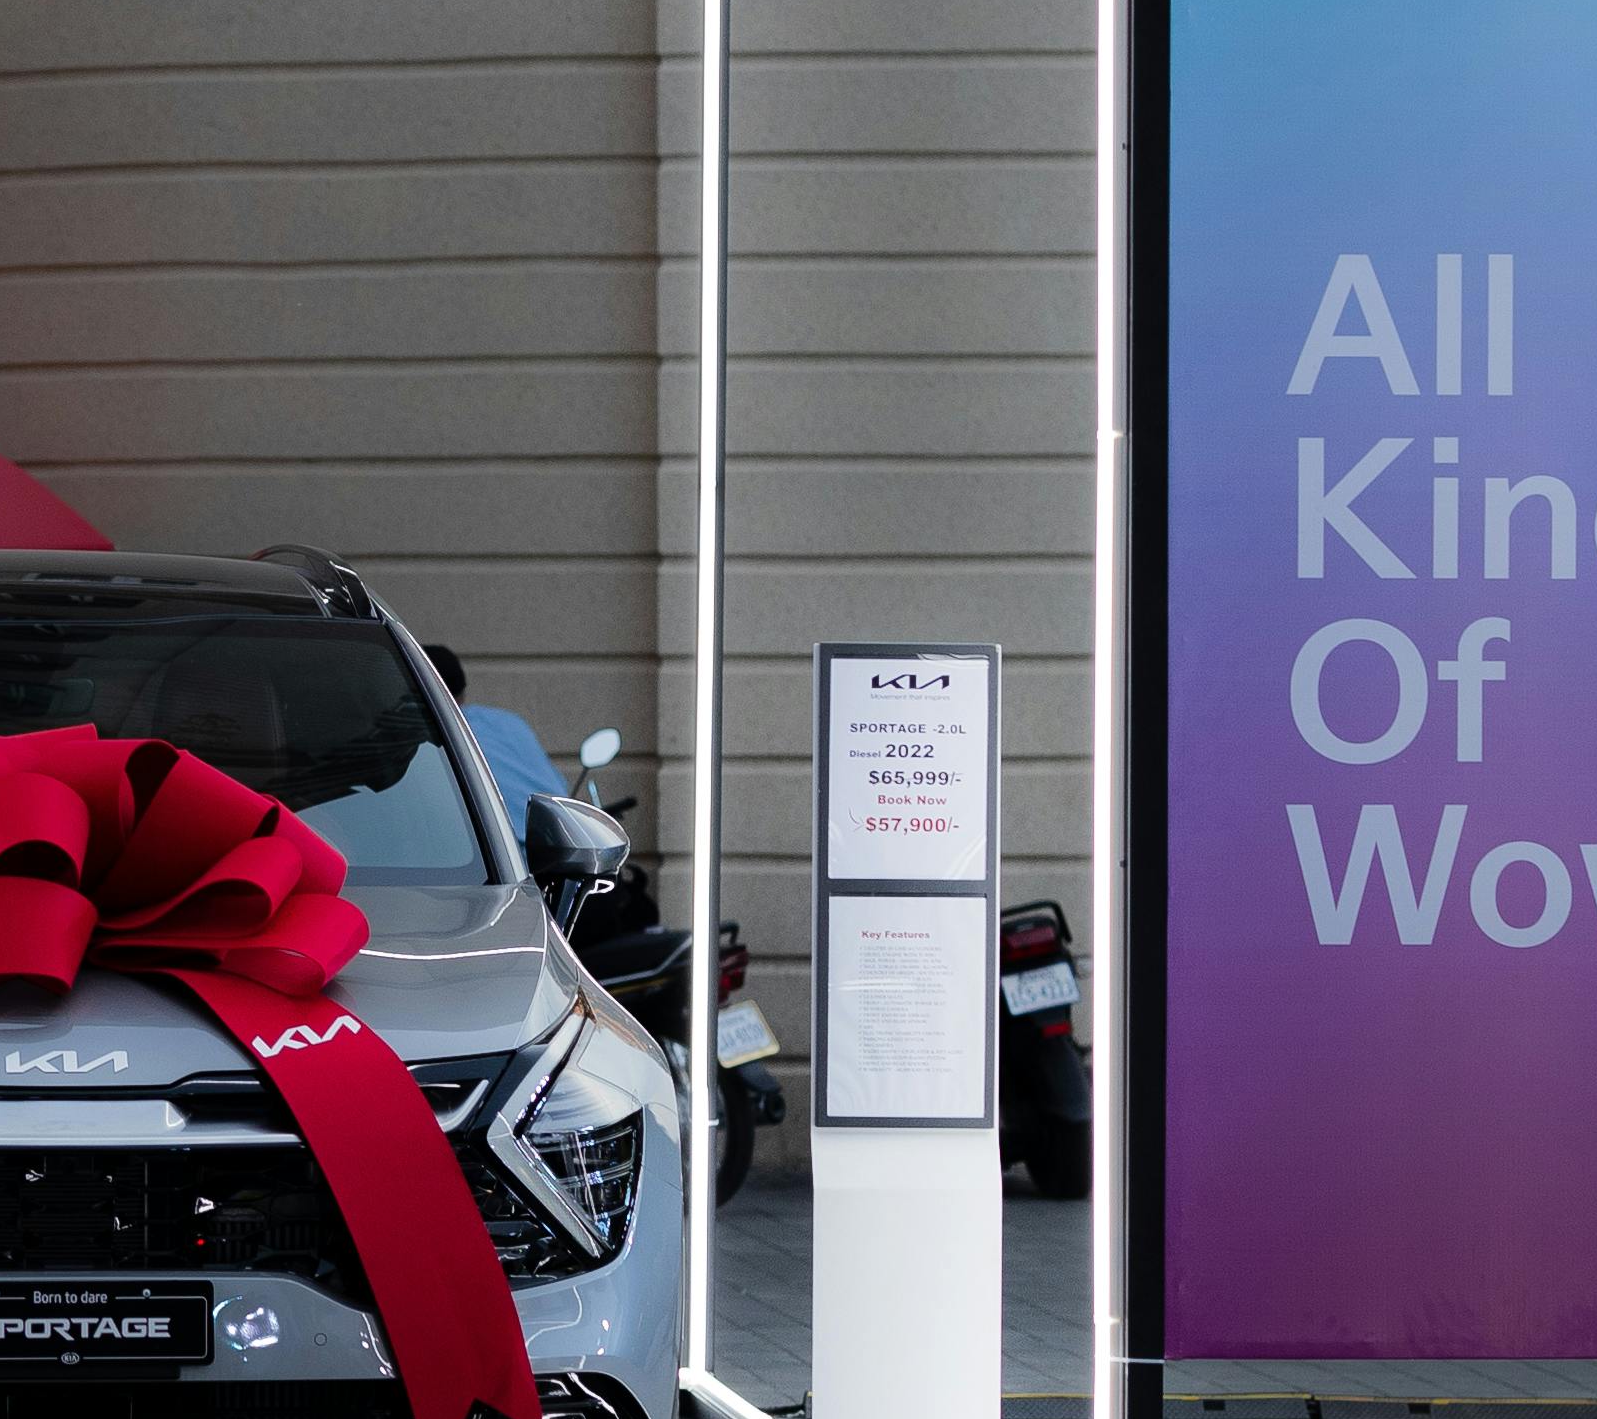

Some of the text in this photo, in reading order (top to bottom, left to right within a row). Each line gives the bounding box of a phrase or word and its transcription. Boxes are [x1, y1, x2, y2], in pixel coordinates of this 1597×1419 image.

[1285, 253, 1514, 396] All
[871, 674, 950, 689] KIA
[1290, 616, 1511, 765] Of
[850, 723, 966, 734] SPORTAGE -2.0L
[849, 744, 934, 758] Diesel 2022
[868, 770, 962, 788] $65,999/-
[878, 794, 947, 805] Book Now
[866, 816, 959, 835] $57,900/-
[861, 930, 930, 940] Key Features
[252, 1014, 361, 1058] KIA
[5, 1050, 129, 1074] KIA
[33, 1291, 108, 1304] Born to dare
[62, 1352, 79, 1364] KIA
